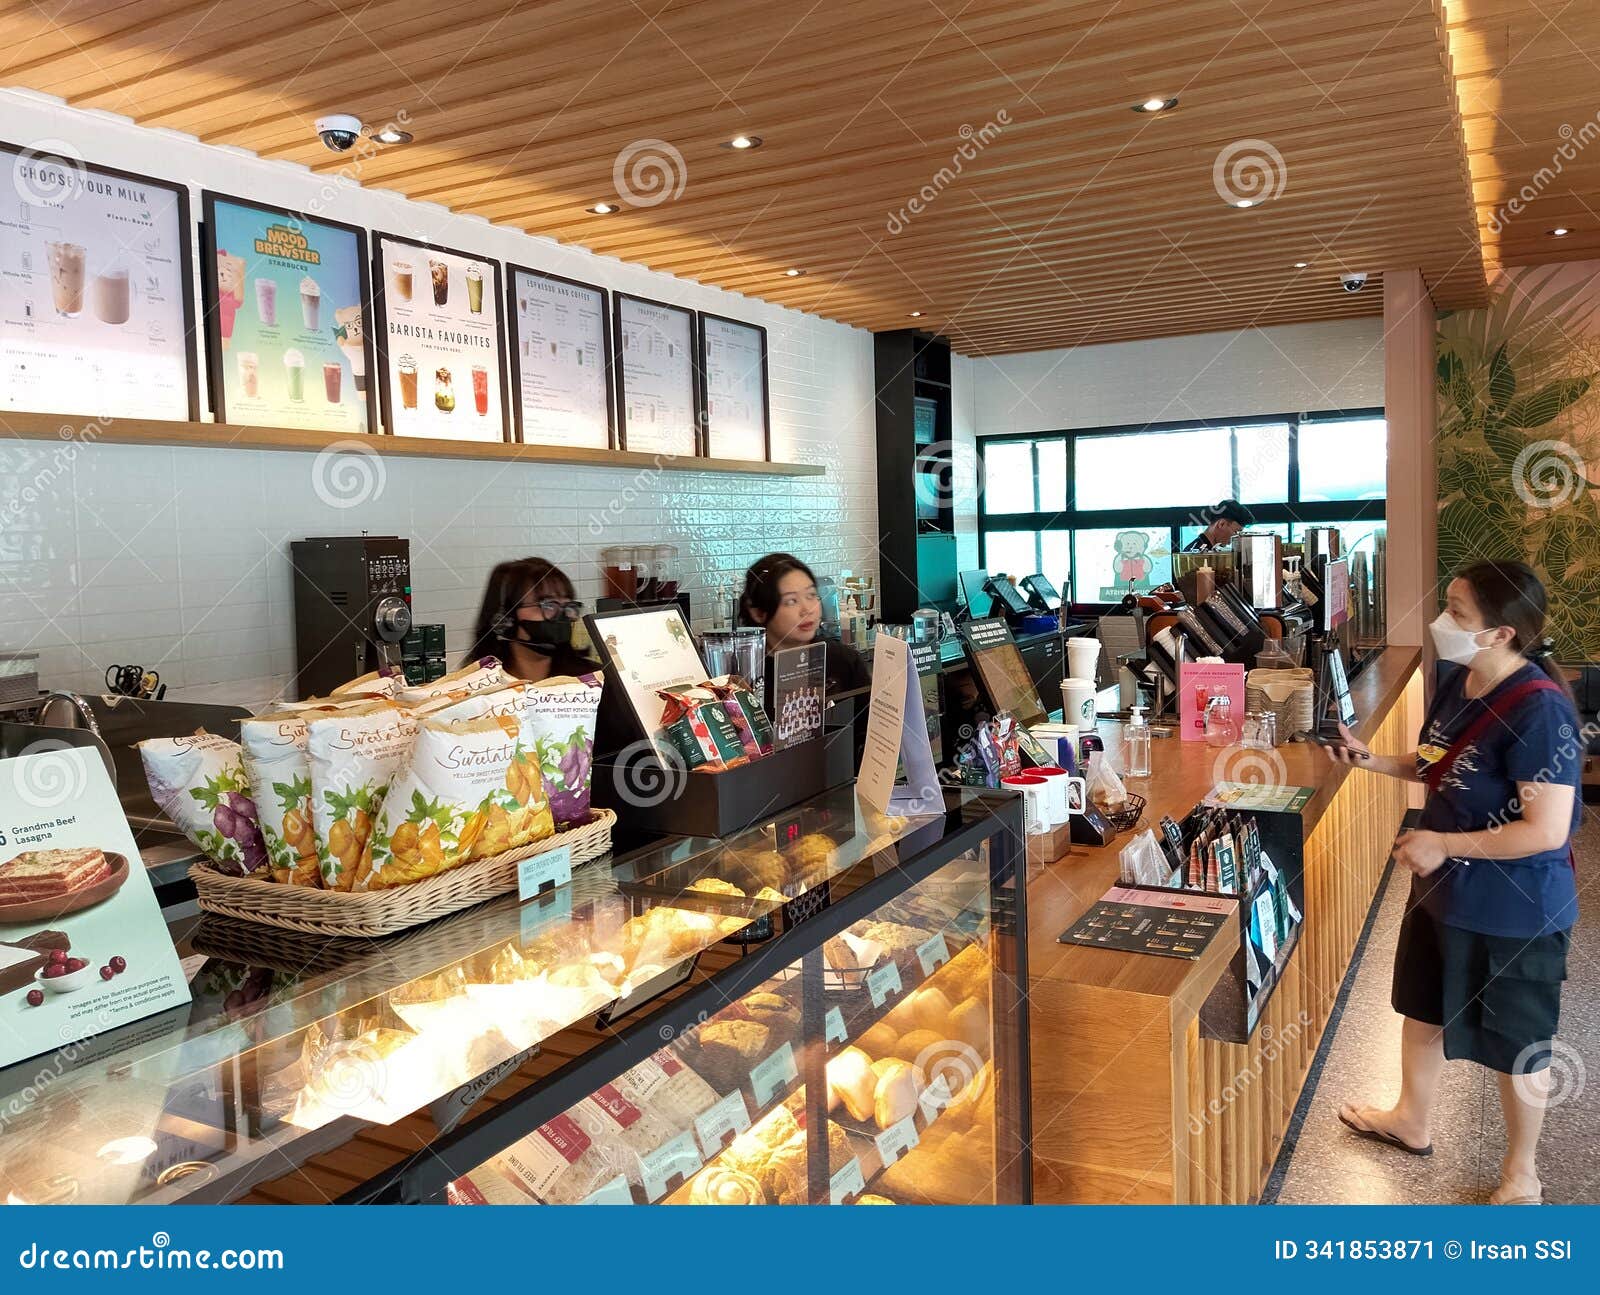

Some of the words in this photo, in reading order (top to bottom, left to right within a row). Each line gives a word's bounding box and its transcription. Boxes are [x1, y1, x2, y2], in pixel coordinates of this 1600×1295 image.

[20, 166, 73, 188] CHOOSE
[79, 178, 112, 197] YOUR
[118, 187, 147, 204] MILK
[267, 228, 308, 249] MOOD
[255, 239, 321, 264] BREWSTER
[268, 258, 308, 271] STARBUCKS
[390, 322, 434, 340] BARISTA
[438, 330, 490, 348] FAVORITES
[434, 744, 514, 769] Sweetato
[11, 822, 55, 835] Grandma
[55, 815, 76, 827] Beef
[15, 832, 53, 845] Lasagna
[70, 1011, 81, 1019] and
[109, 999, 122, 1007] from
[133, 990, 148, 999] actual
[72, 1000, 92, 1010] Images
[101, 993, 110, 1001] for
[138, 979, 158, 991] purpose
[134, 993, 161, 1007] conditions
[161, 989, 175, 998] apply
[521, 1167, 537, 1184] BEEF
